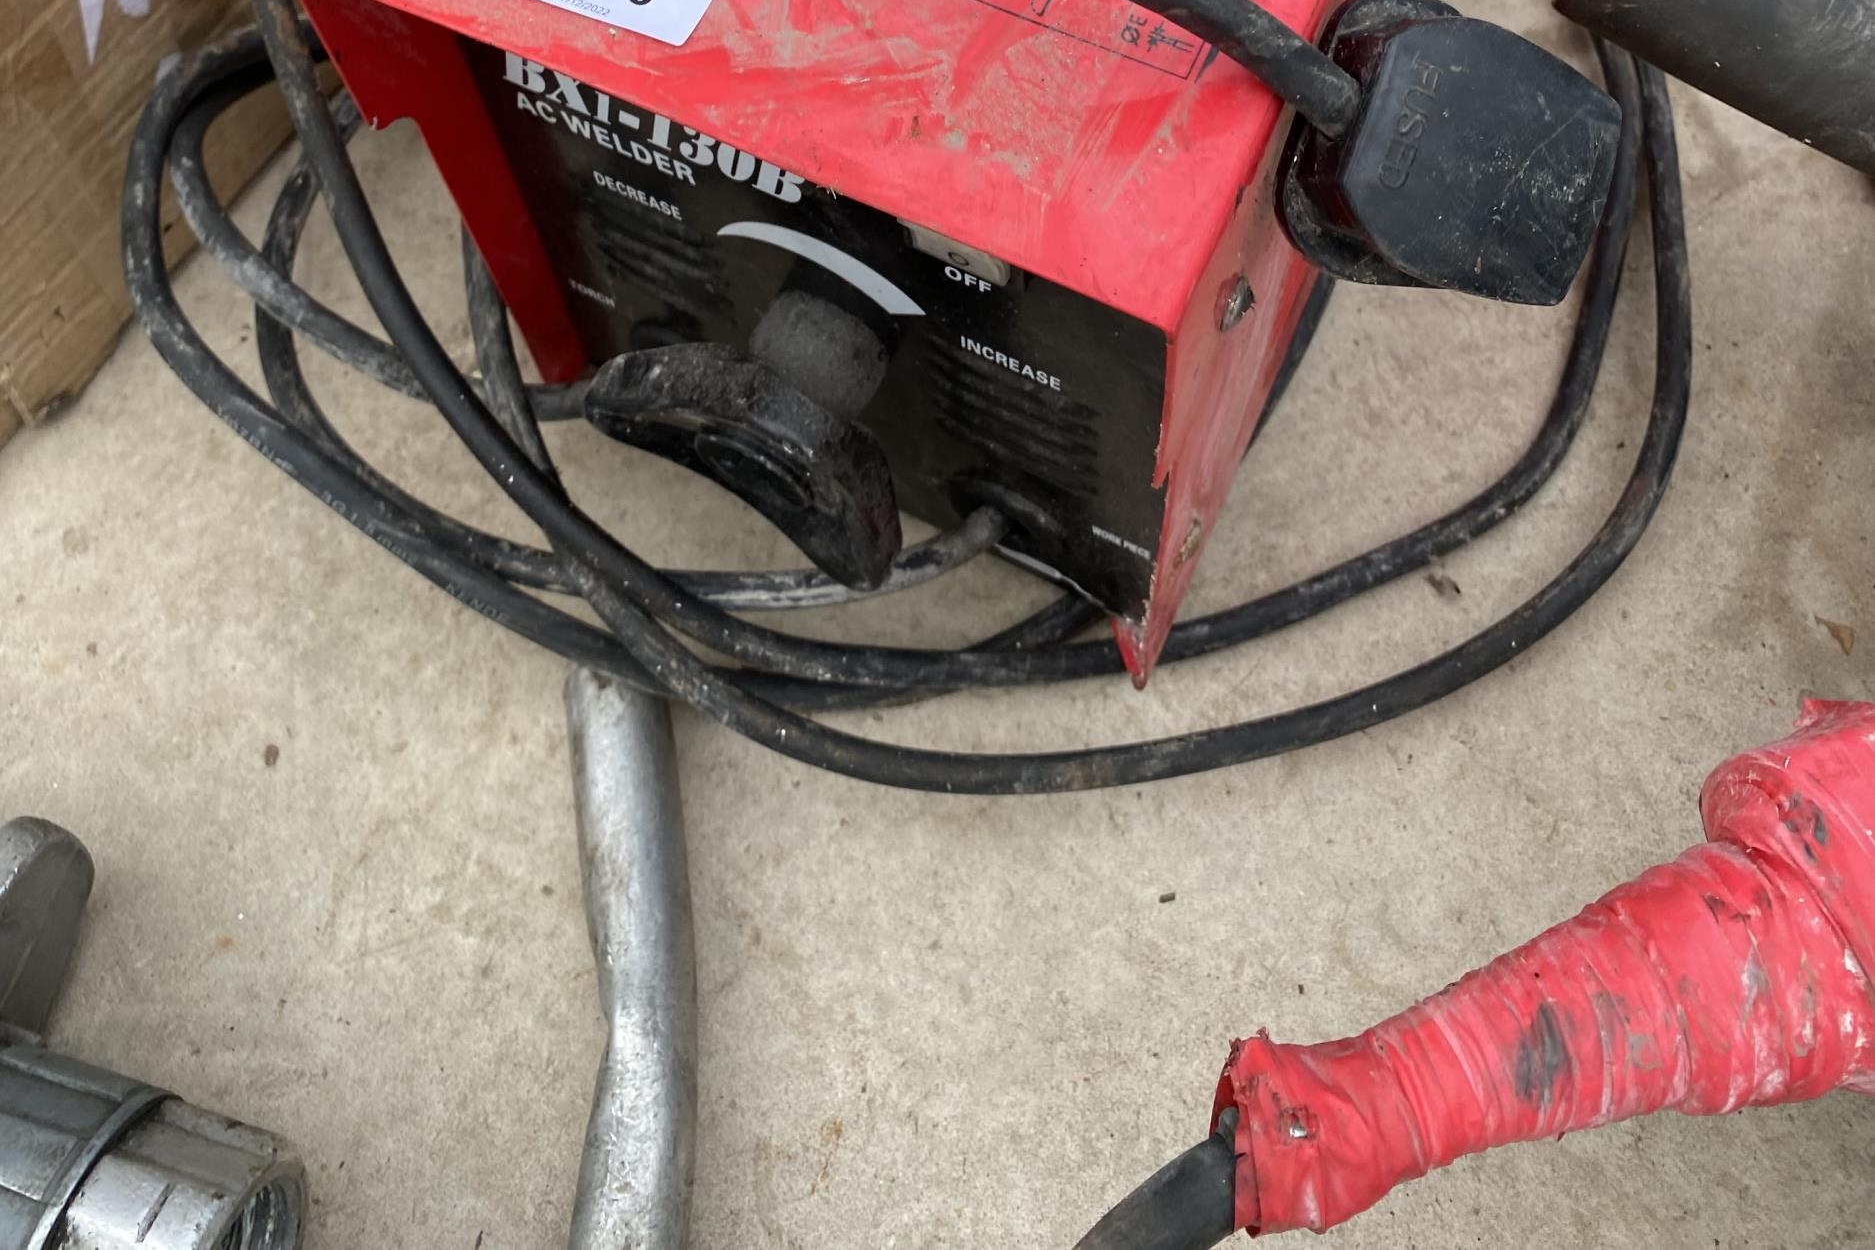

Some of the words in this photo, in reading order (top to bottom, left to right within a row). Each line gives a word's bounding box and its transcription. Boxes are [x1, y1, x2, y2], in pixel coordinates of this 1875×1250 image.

[516, 91, 557, 124] AC
[560, 114, 697, 187] WELDER
[593, 169, 683, 221] DECREASE
[944, 265, 993, 293] OFF
[959, 335, 1062, 392] INCREASE
[1091, 525, 1122, 547] WORK
[1122, 539, 1152, 561] PIECE
